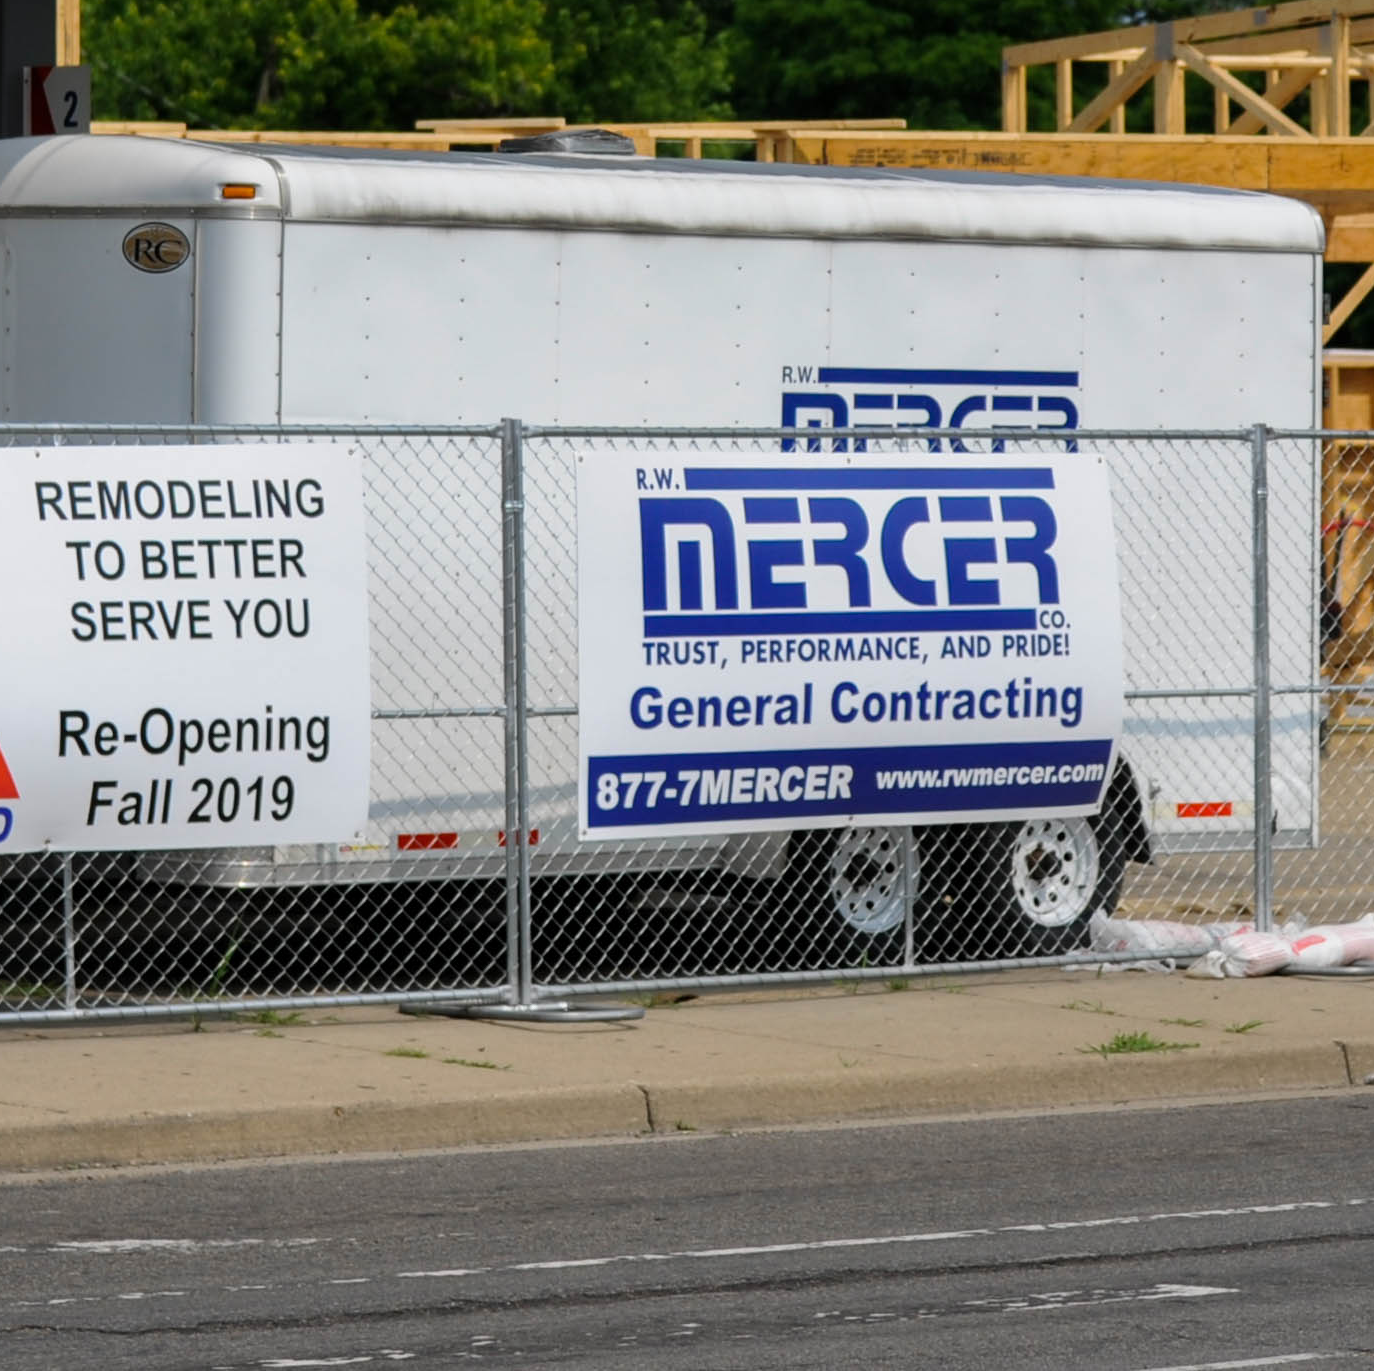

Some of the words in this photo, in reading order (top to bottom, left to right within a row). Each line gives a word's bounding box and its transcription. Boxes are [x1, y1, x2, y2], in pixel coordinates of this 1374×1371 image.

[63, 90, 79, 128] 2
[134, 237, 183, 265] RC
[781, 366, 817, 384] R.W.
[35, 478, 325, 521] REMODELING
[636, 468, 681, 492] R.W.
[66, 540, 126, 581] TO
[140, 539, 307, 580] BETTER
[638, 495, 1060, 611] MERCER
[71, 599, 213, 642] SERVE
[224, 598, 310, 639] YOU
[1039, 610, 1071, 629] CO.
[642, 640, 728, 670] TRUST,
[741, 636, 929, 665] PERFORMANCE,
[940, 635, 992, 659] AND
[1002, 633, 1071, 658] PRIDE!
[629, 682, 813, 730] General
[831, 677, 1083, 728] Contracting
[58, 704, 331, 766] Re-Opening
[595, 764, 855, 811] 877-7MERCER
[875, 763, 1105, 791] www.rwmercer.com
[85, 778, 173, 826] Fall
[187, 775, 296, 824] 2019
